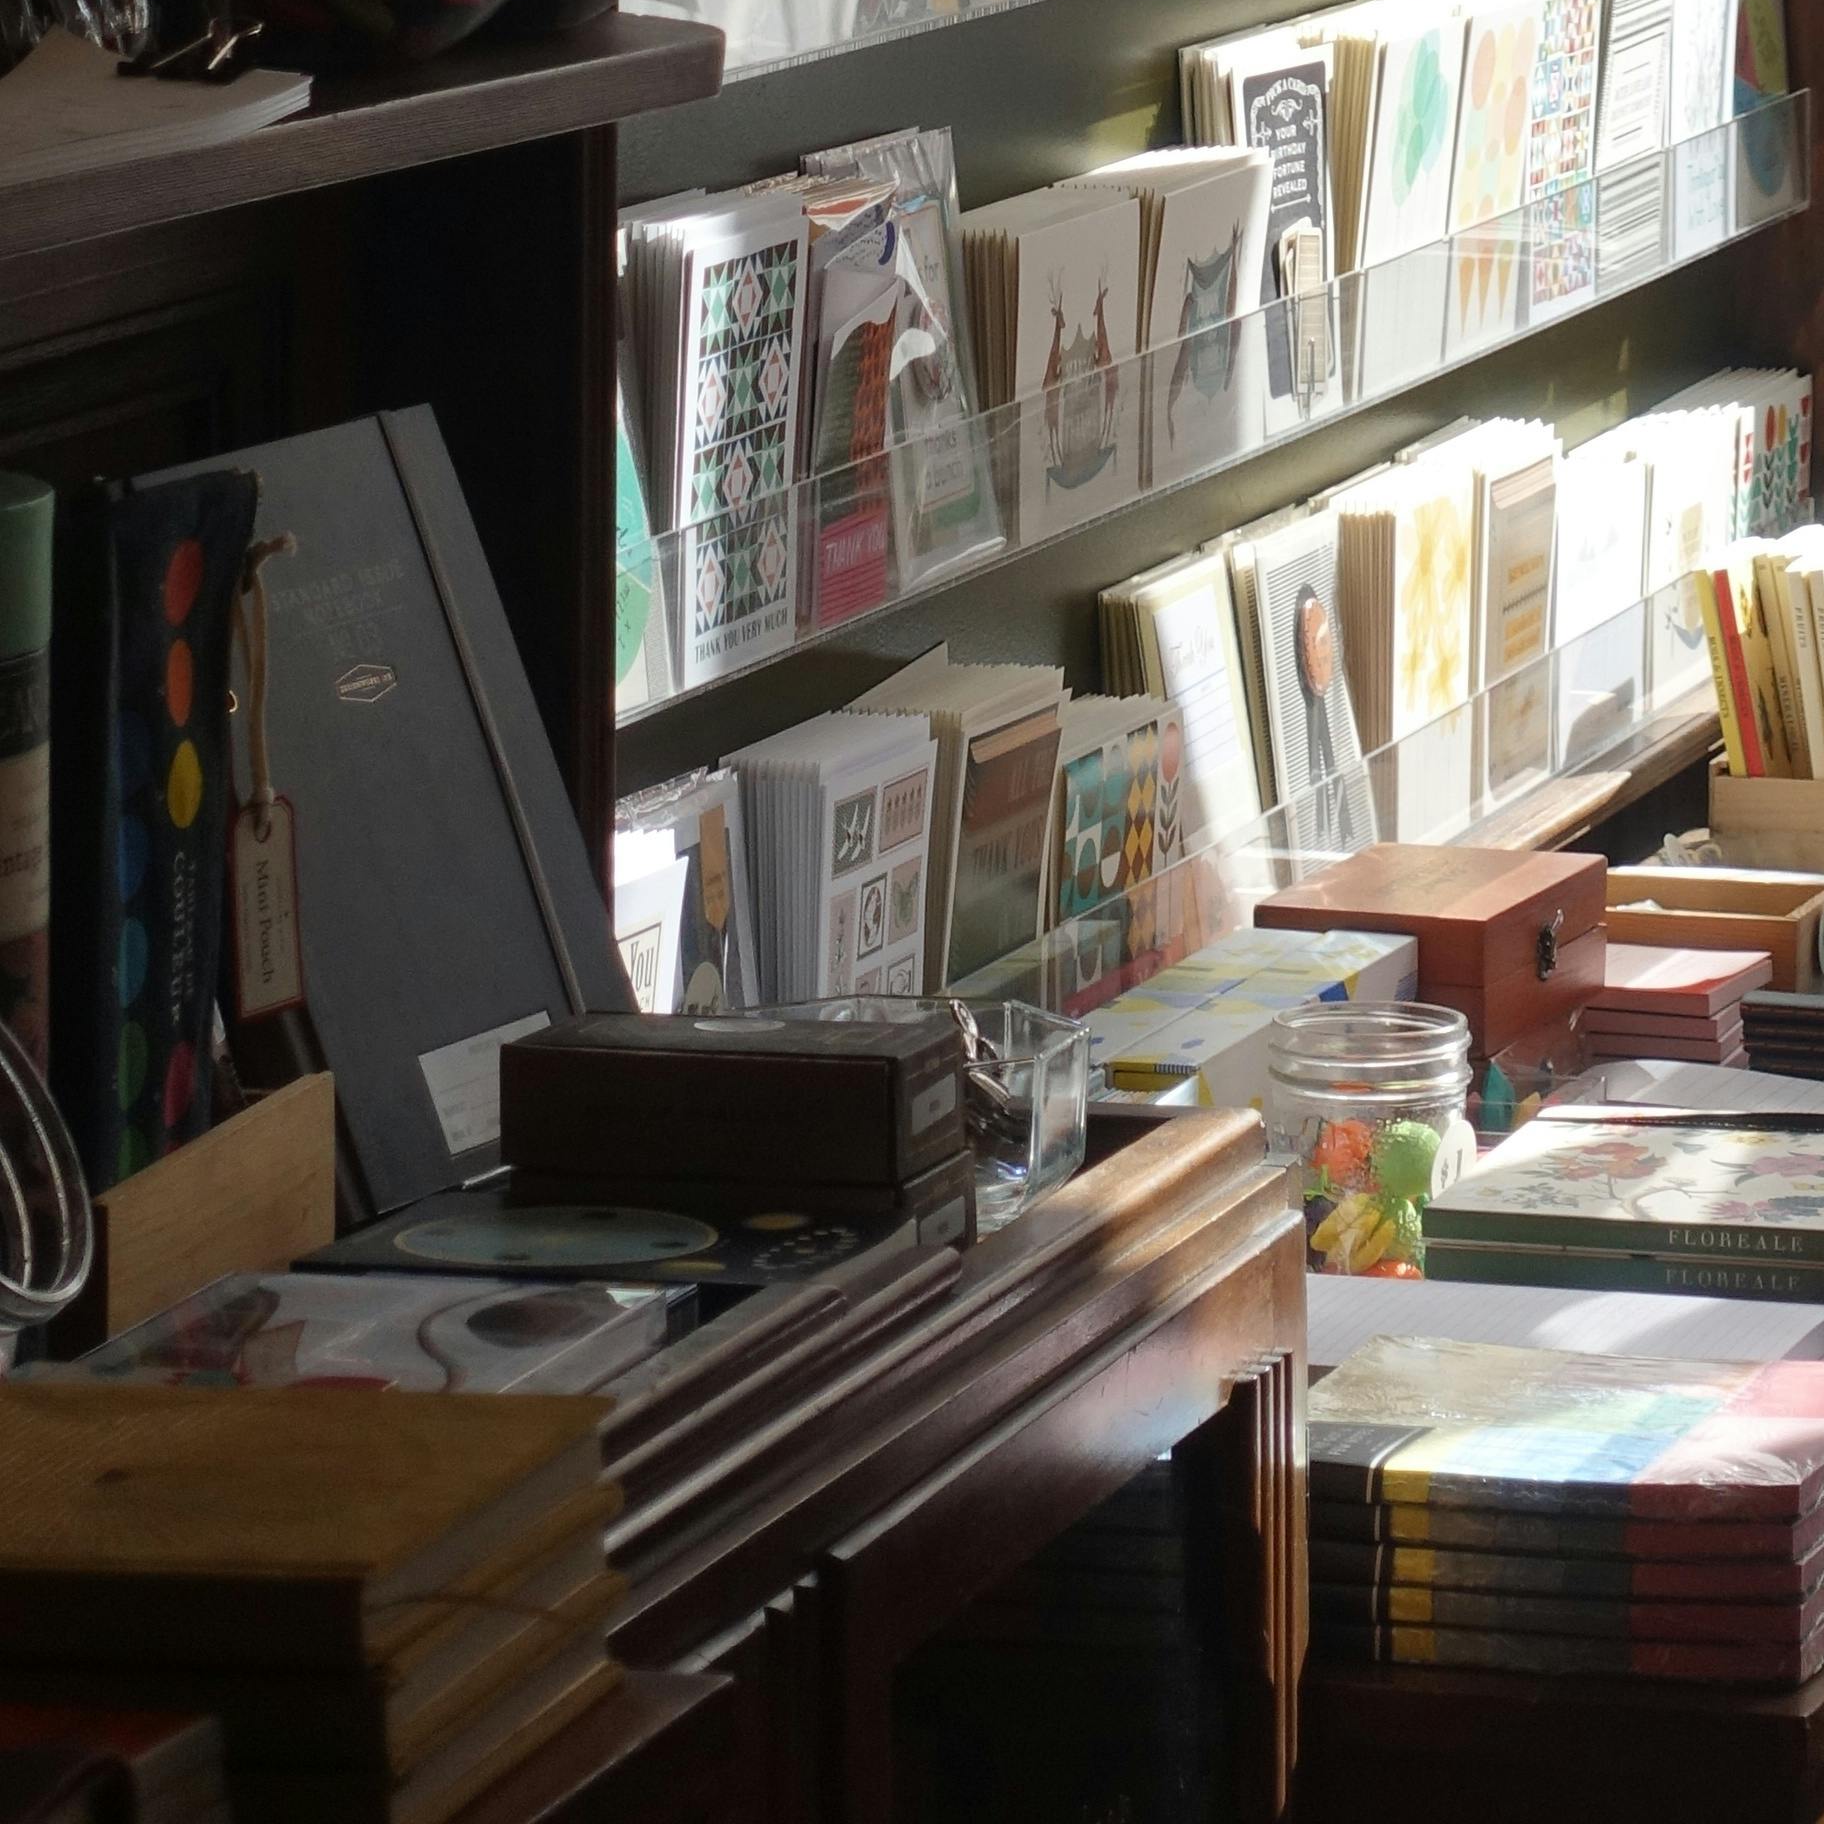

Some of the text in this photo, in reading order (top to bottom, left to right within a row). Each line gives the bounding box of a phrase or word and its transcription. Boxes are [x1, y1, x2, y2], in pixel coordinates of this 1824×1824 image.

[1275, 125, 1298, 141] YOUR
[1272, 178, 1308, 199] REVEALED
[825, 523, 887, 575] THANK YOU
[694, 611, 789, 663] THANK YOU VERY MUCH
[1794, 606, 1808, 650] FRUITS
[1440, 1148, 1464, 1191] $1
[1668, 1229, 1804, 1254] FLOREALE
[1664, 1268, 1802, 1292] FLOREALE
